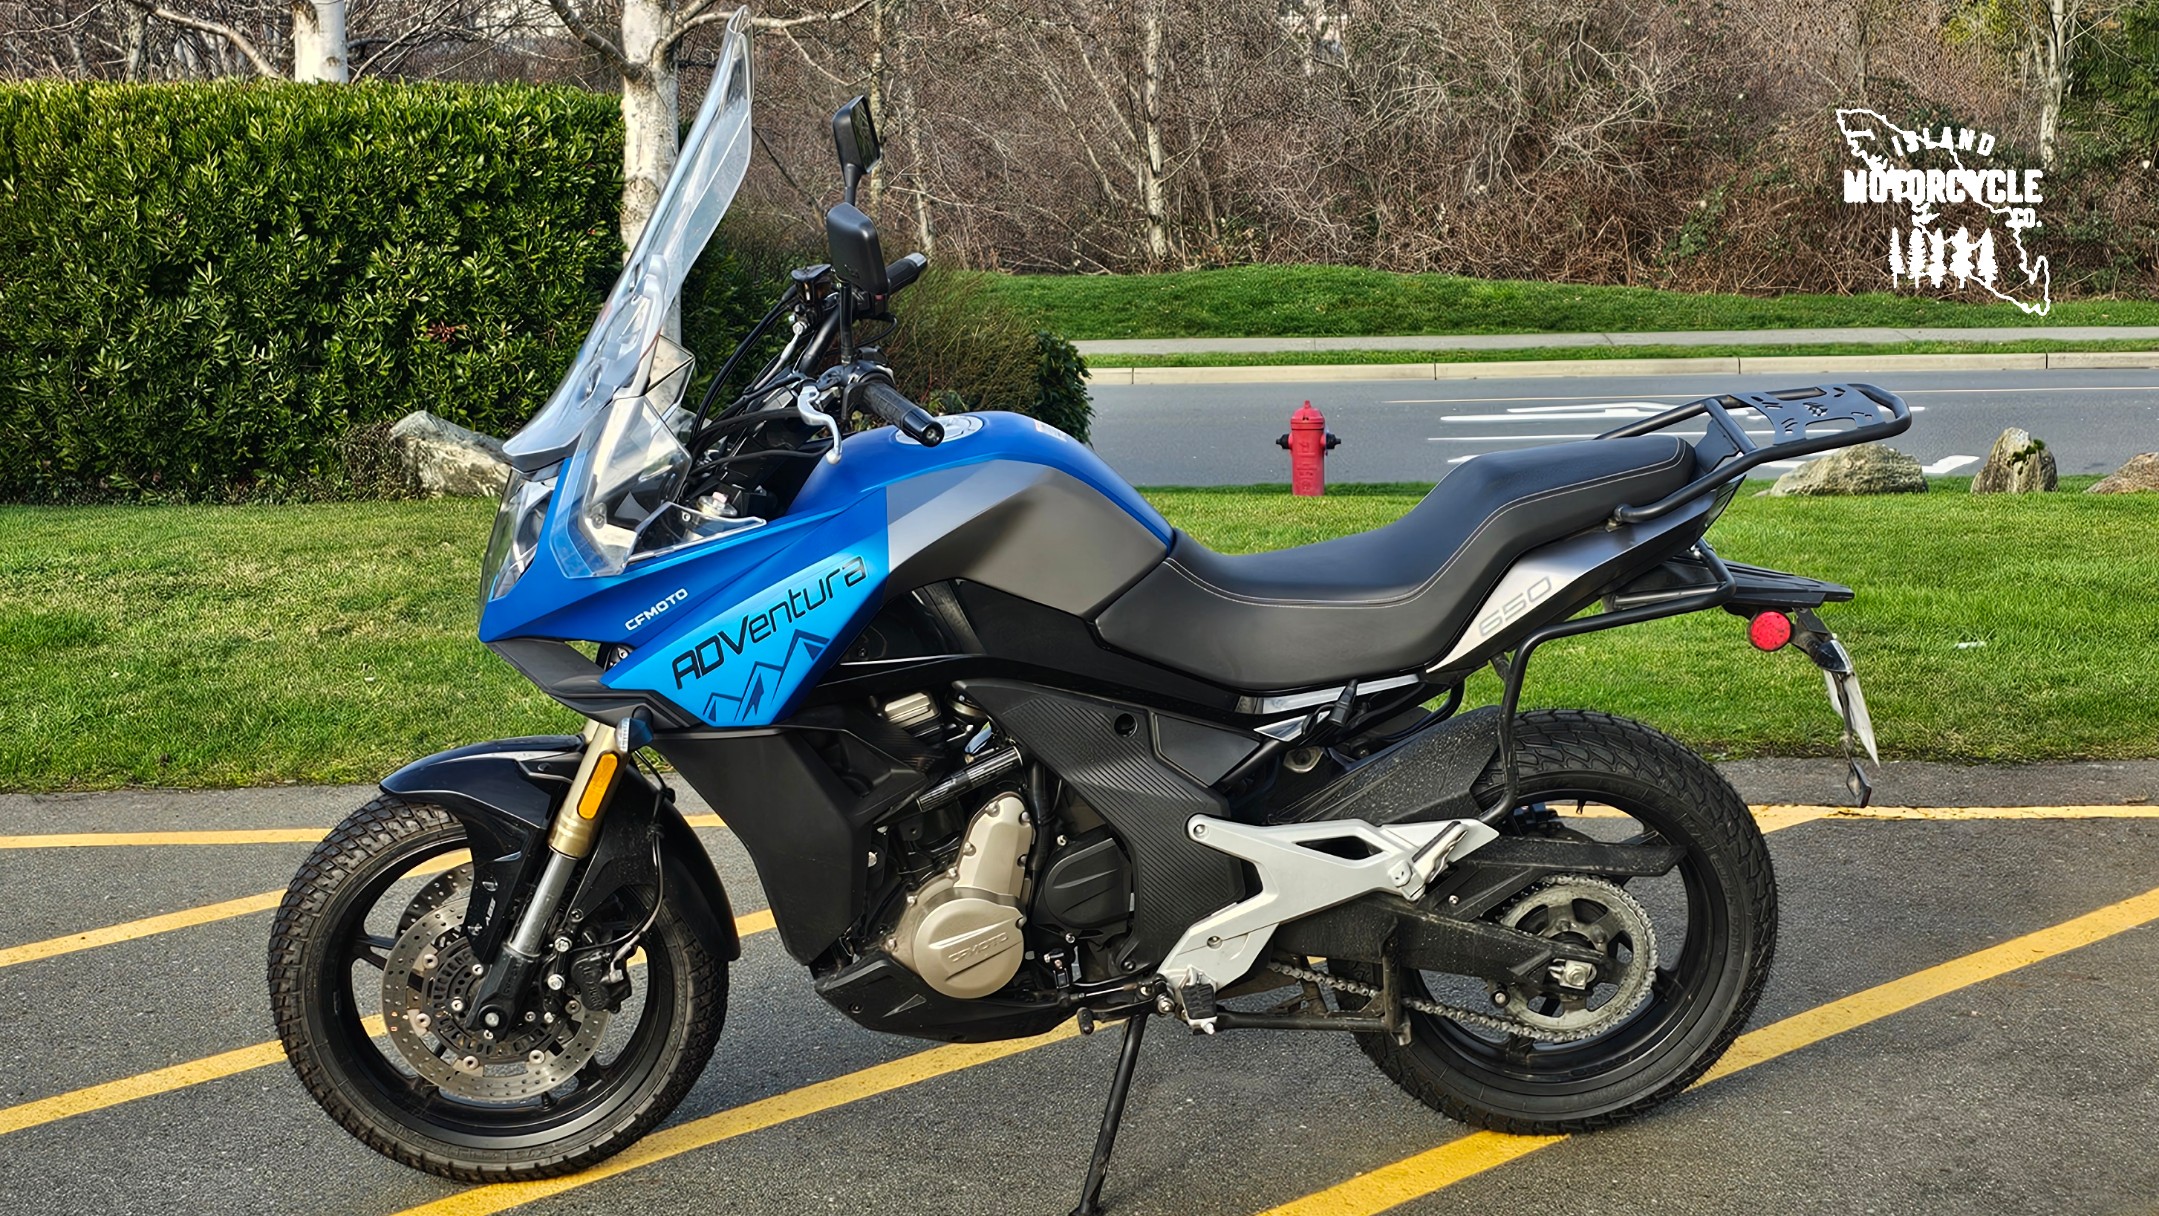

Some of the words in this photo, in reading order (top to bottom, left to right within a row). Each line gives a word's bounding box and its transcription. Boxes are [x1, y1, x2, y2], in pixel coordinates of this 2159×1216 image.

[624, 588, 689, 631] CFMOTO
[672, 556, 867, 689] ADVentura
[1479, 576, 1552, 636] 650
